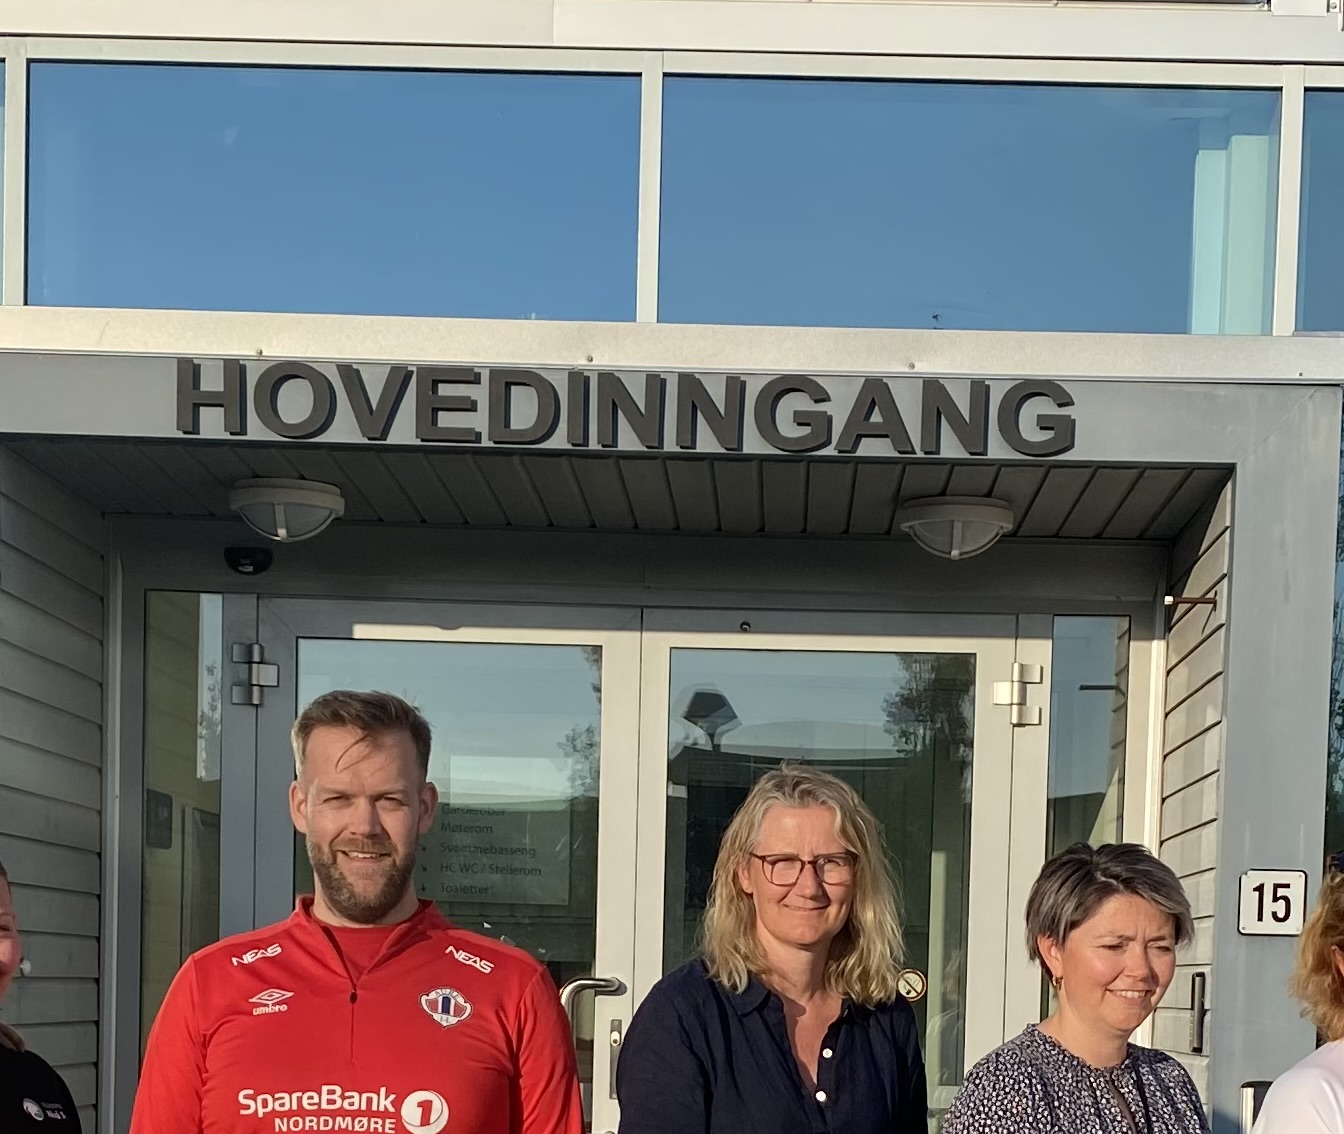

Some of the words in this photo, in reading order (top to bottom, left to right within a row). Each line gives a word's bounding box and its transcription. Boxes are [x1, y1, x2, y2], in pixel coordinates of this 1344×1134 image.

[175, 358, 1075, 457] HOVEDINNGANG
[441, 822, 493, 833] Møterom
[459, 863, 479, 874] WC
[441, 883, 490, 895] Toaletter
[1252, 882, 1292, 923] 15
[231, 943, 283, 966] NEAS
[445, 945, 495, 974] NEAS
[252, 1003, 288, 1016] umbro
[238, 1085, 397, 1118] SpareBank
[274, 1116, 397, 1134] NORDMØRE
